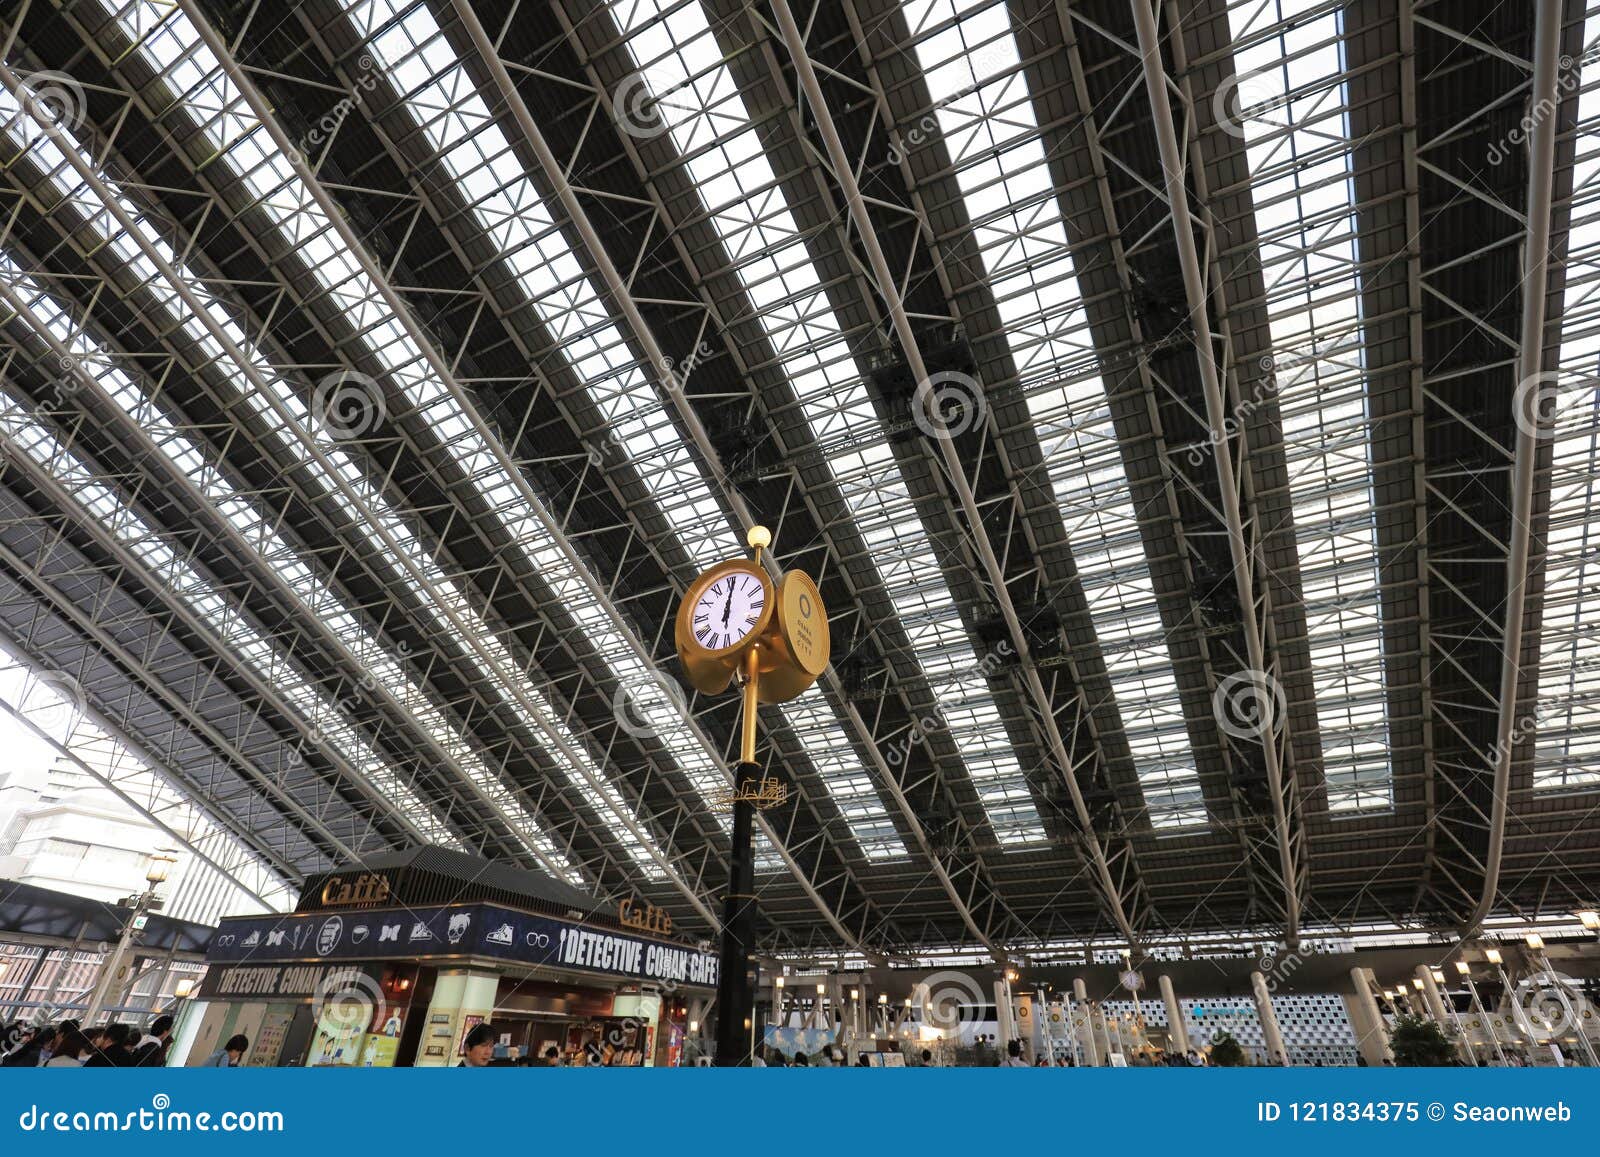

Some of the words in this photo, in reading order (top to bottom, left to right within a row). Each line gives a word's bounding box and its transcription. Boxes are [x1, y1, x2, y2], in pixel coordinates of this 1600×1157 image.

[564, 928, 643, 974] DETECTIVE
[645, 944, 687, 982] CONAN
[690, 953, 717, 985] CAFE
[220, 967, 281, 993] DETECTIVE
[279, 967, 324, 994] CONAN
